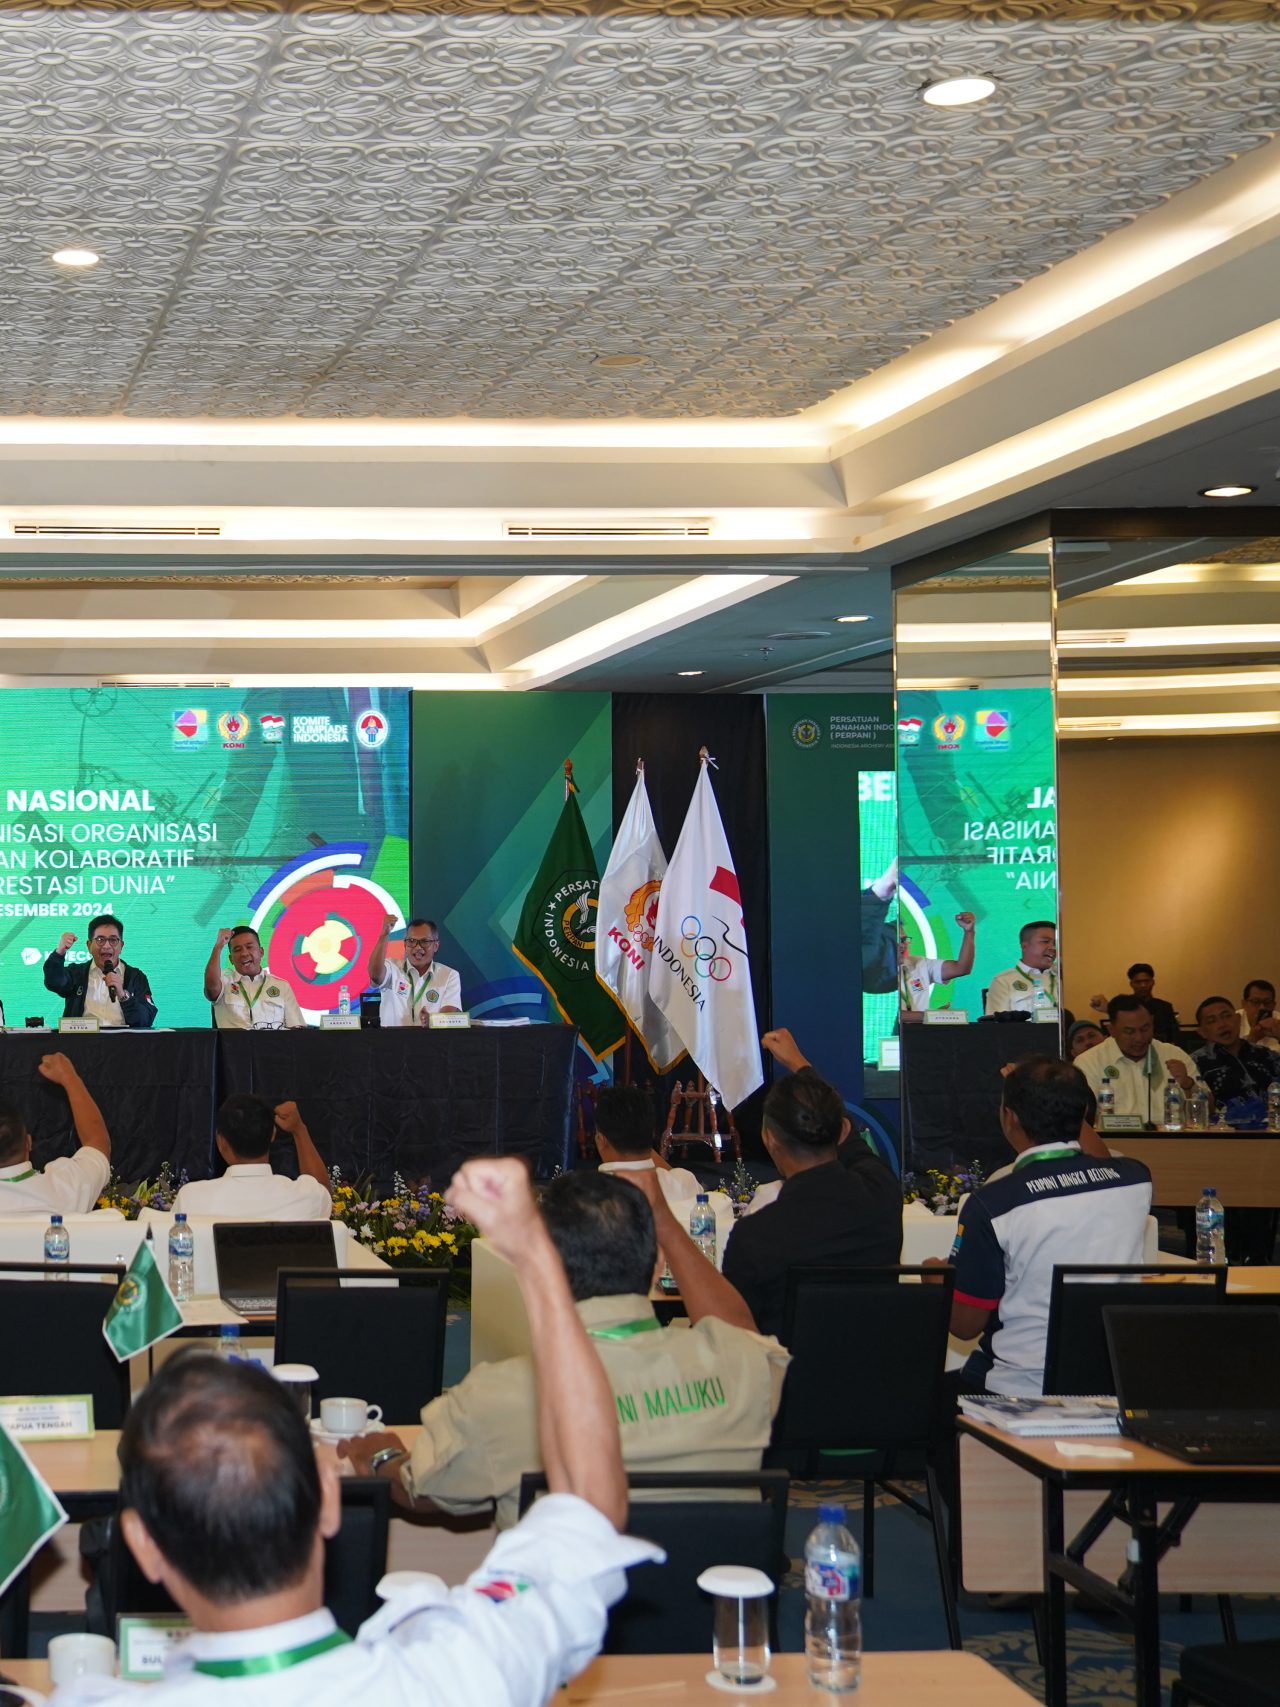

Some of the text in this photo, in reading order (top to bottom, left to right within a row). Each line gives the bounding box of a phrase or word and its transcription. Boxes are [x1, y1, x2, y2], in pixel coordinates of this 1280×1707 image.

[293, 716, 331, 725] KOMITE
[293, 725, 348, 734] OLIMPIADE
[293, 733, 349, 742] INDONESIA
[7, 788, 156, 812] NASIONAL
[71, 822, 218, 843] ORGANISASI
[34, 848, 195, 869] KOLABORATIF
[72, 902, 114, 916] 2024
[544, 912, 590, 971] INDONESIA
[563, 919, 586, 949] PERPANI
[608, 926, 646, 970] KONI
[653, 935, 706, 1012] INDONESIA
[1025, 1175, 1059, 1194] PERPANI
[1057, 1170, 1089, 1188] BANGKA
[642, 1375, 726, 1420] MALUKU
[7, 1421, 73, 1431] APUA TENGAH
